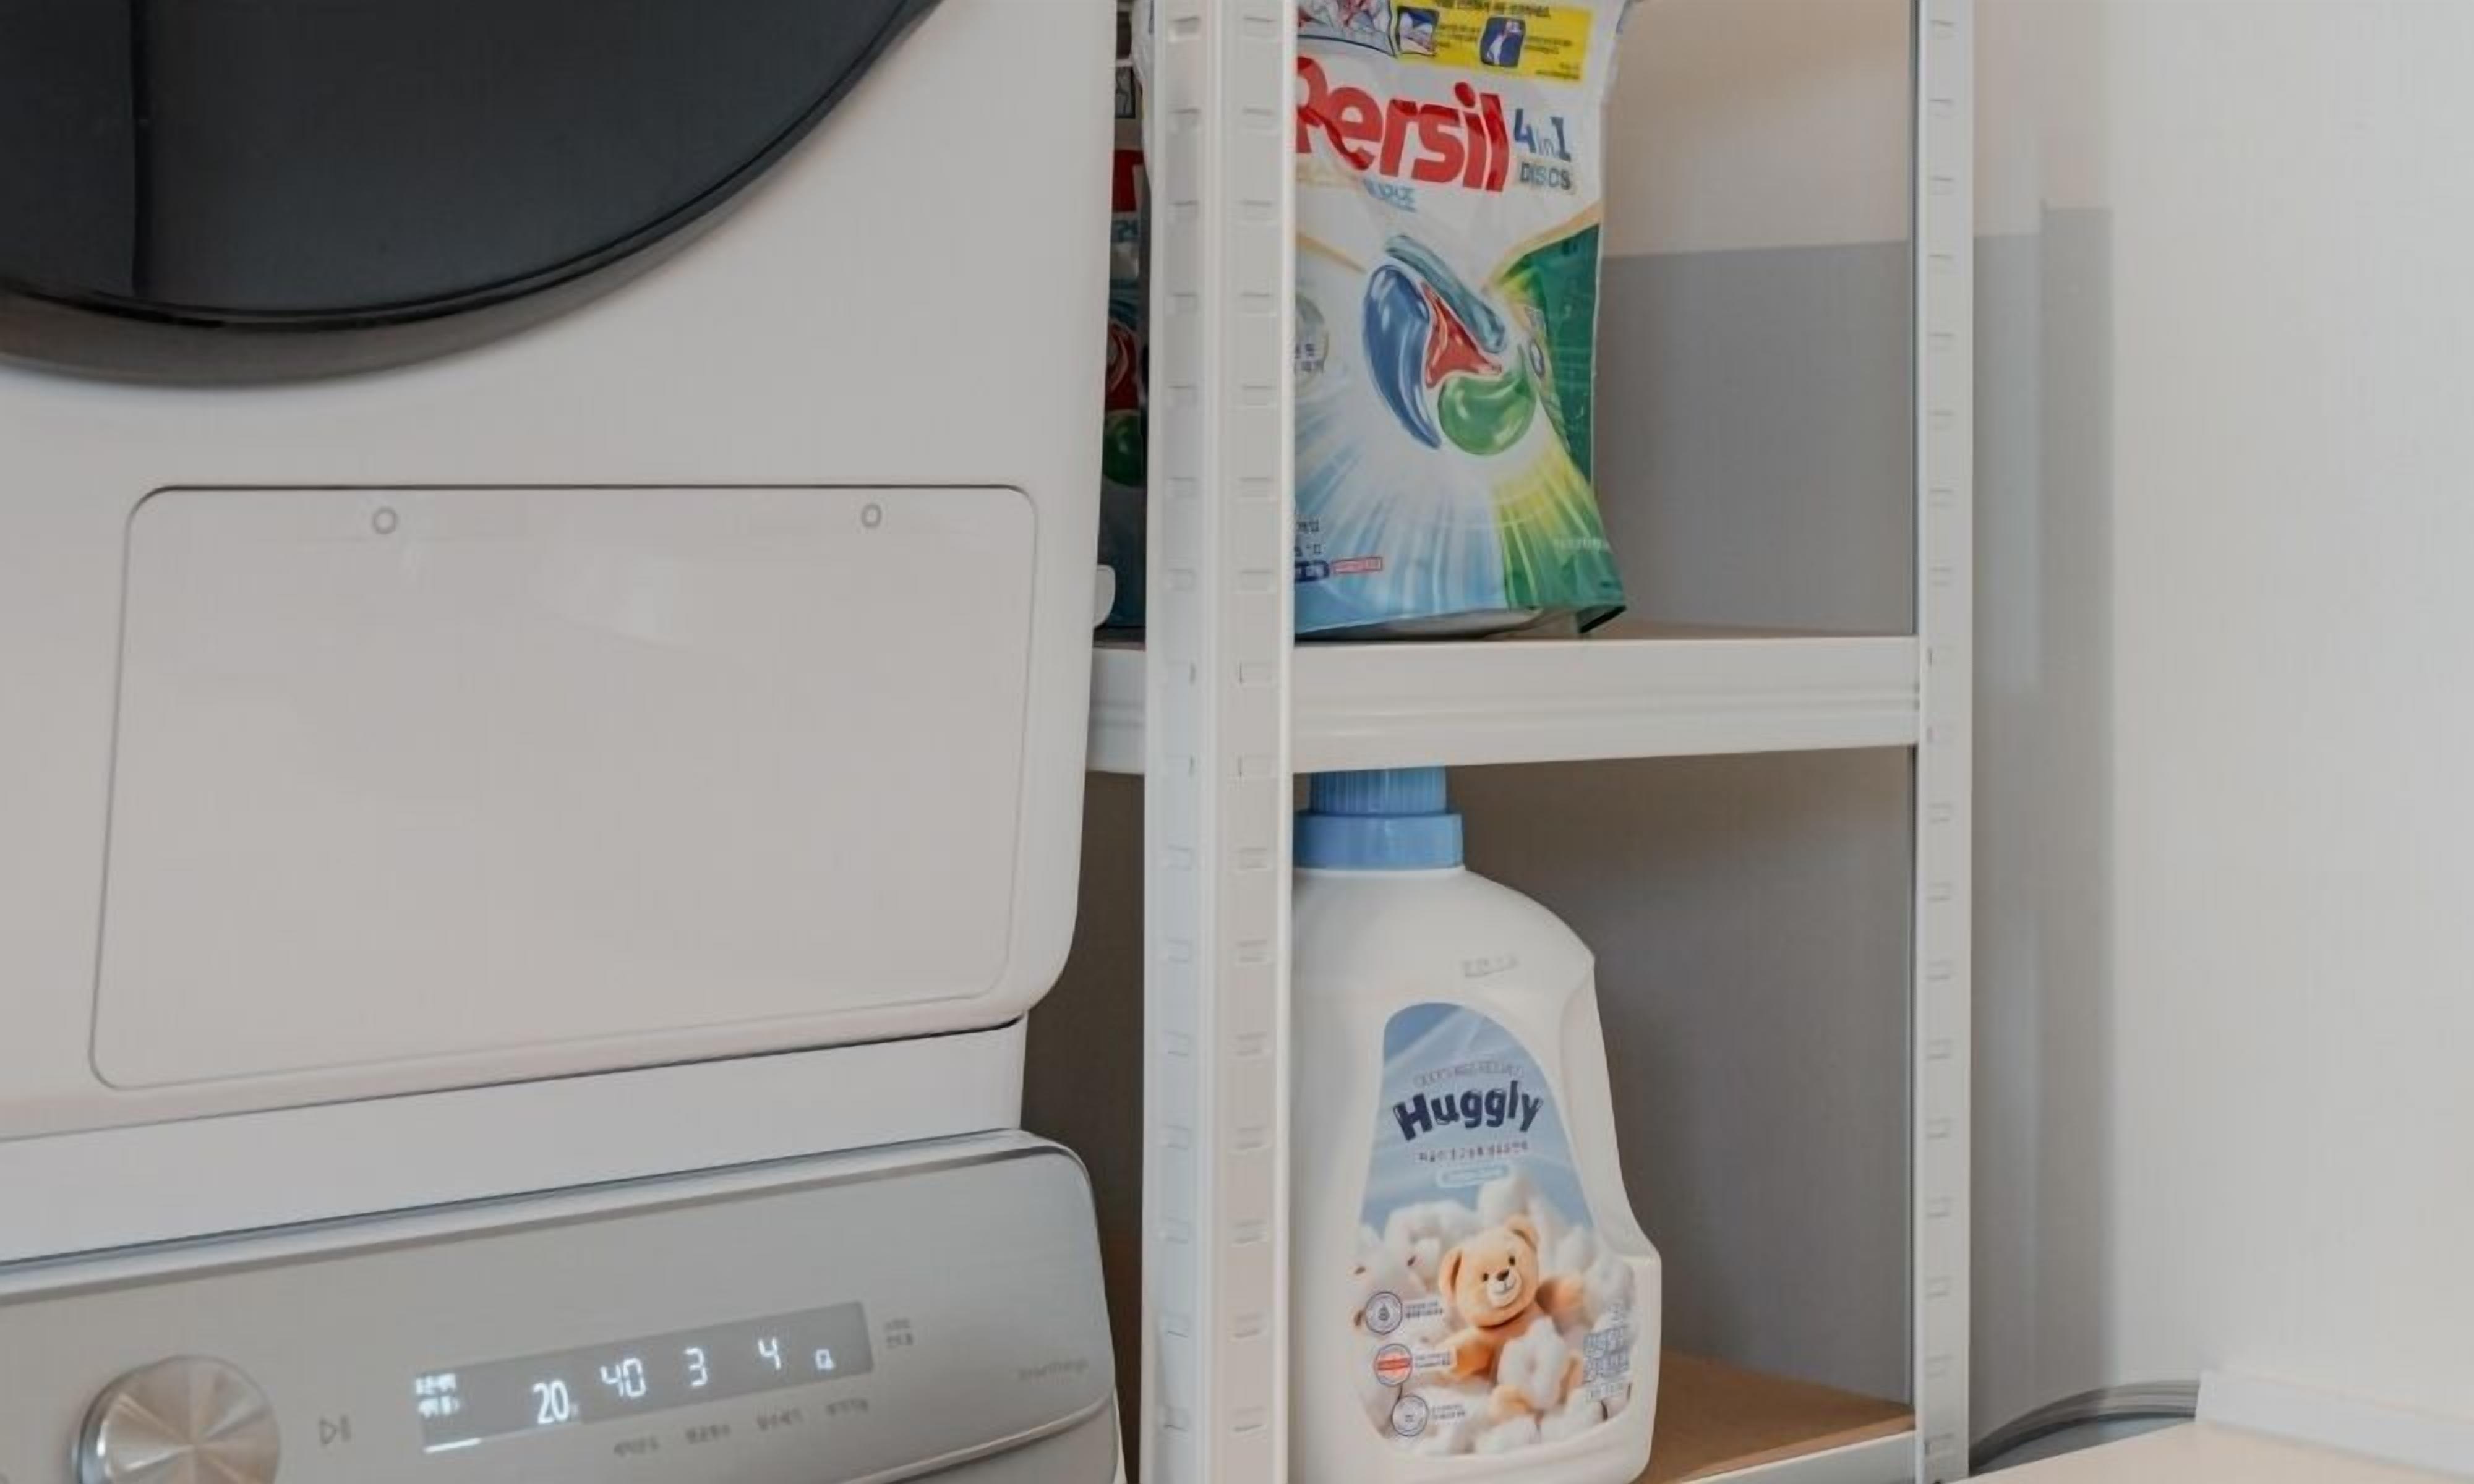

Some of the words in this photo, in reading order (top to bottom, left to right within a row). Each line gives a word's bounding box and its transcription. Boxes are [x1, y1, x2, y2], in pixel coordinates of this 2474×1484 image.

[1296, 56, 1509, 192] Persil
[1520, 161, 1572, 190] DISCS
[1393, 1080, 1544, 1141] Huggly
[533, 1378, 569, 1425] 20
[600, 1358, 646, 1398] 40
[684, 1347, 708, 1386] 3
[757, 1337, 781, 1370] 4
